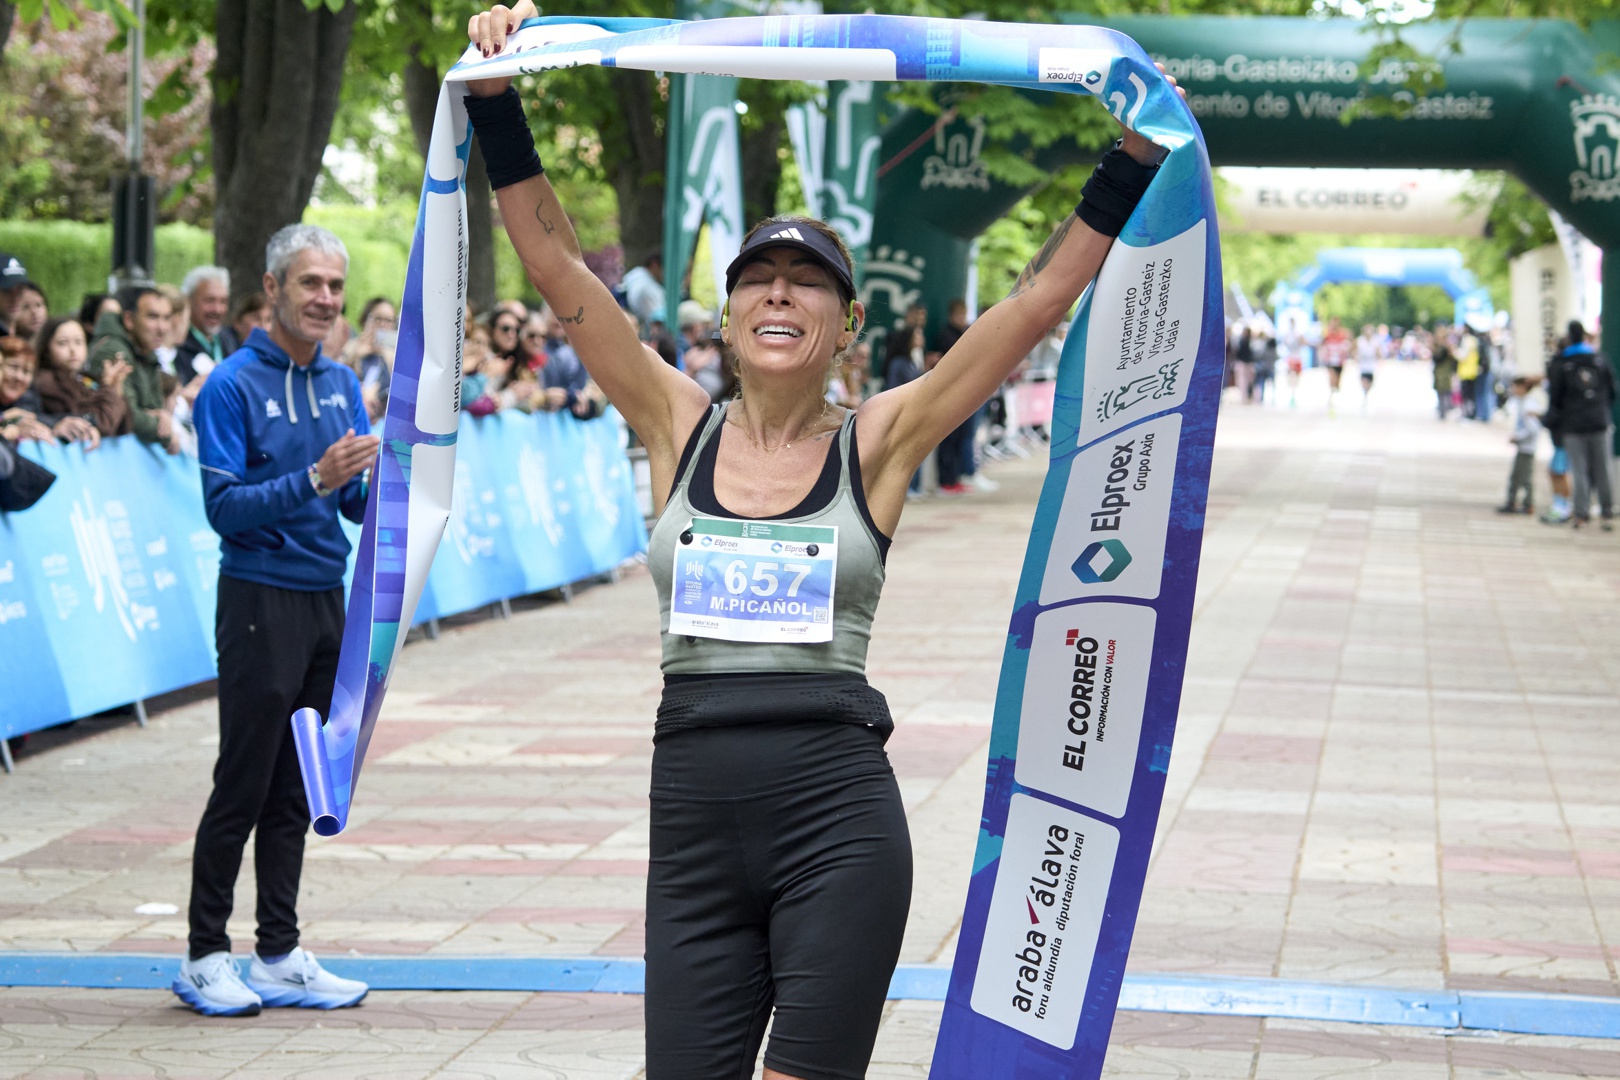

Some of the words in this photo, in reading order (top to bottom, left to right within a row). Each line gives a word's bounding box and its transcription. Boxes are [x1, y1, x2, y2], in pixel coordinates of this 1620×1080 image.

[1047, 72, 1083, 82] Elproex
[1254, 91, 1291, 119] de
[1257, 188, 1287, 208] EL
[1295, 188, 1410, 210] CORREO
[1133, 261, 1156, 352] Vitoria-Gasteiz
[1148, 258, 1173, 359] Vitoria-Gasteizko
[1116, 287, 1137, 371] Ayuntamiento
[1163, 319, 1180, 353] Udala
[1131, 350, 1144, 365] de
[1140, 433, 1155, 457] Axia
[1090, 439, 1135, 532] Elproex
[1133, 458, 1151, 491] Grupo
[785, 544, 808, 554] Elproe
[724, 559, 812, 598] 657
[710, 596, 812, 616] M.PICAÑOL
[1105, 639, 1117, 665] VALOR
[1067, 637, 1099, 736] CORREO
[1103, 666, 1113, 684] CON
[1096, 685, 1110, 742] INFORMACIÓN
[1062, 741, 1086, 771] EL
[1029, 824, 1069, 907] álava
[1034, 995, 1049, 1020] foru
[1043, 937, 1063, 992] aldundia
[1055, 867, 1078, 931] diputación
[1069, 831, 1085, 862] foral
[1012, 930, 1047, 1013] araba
